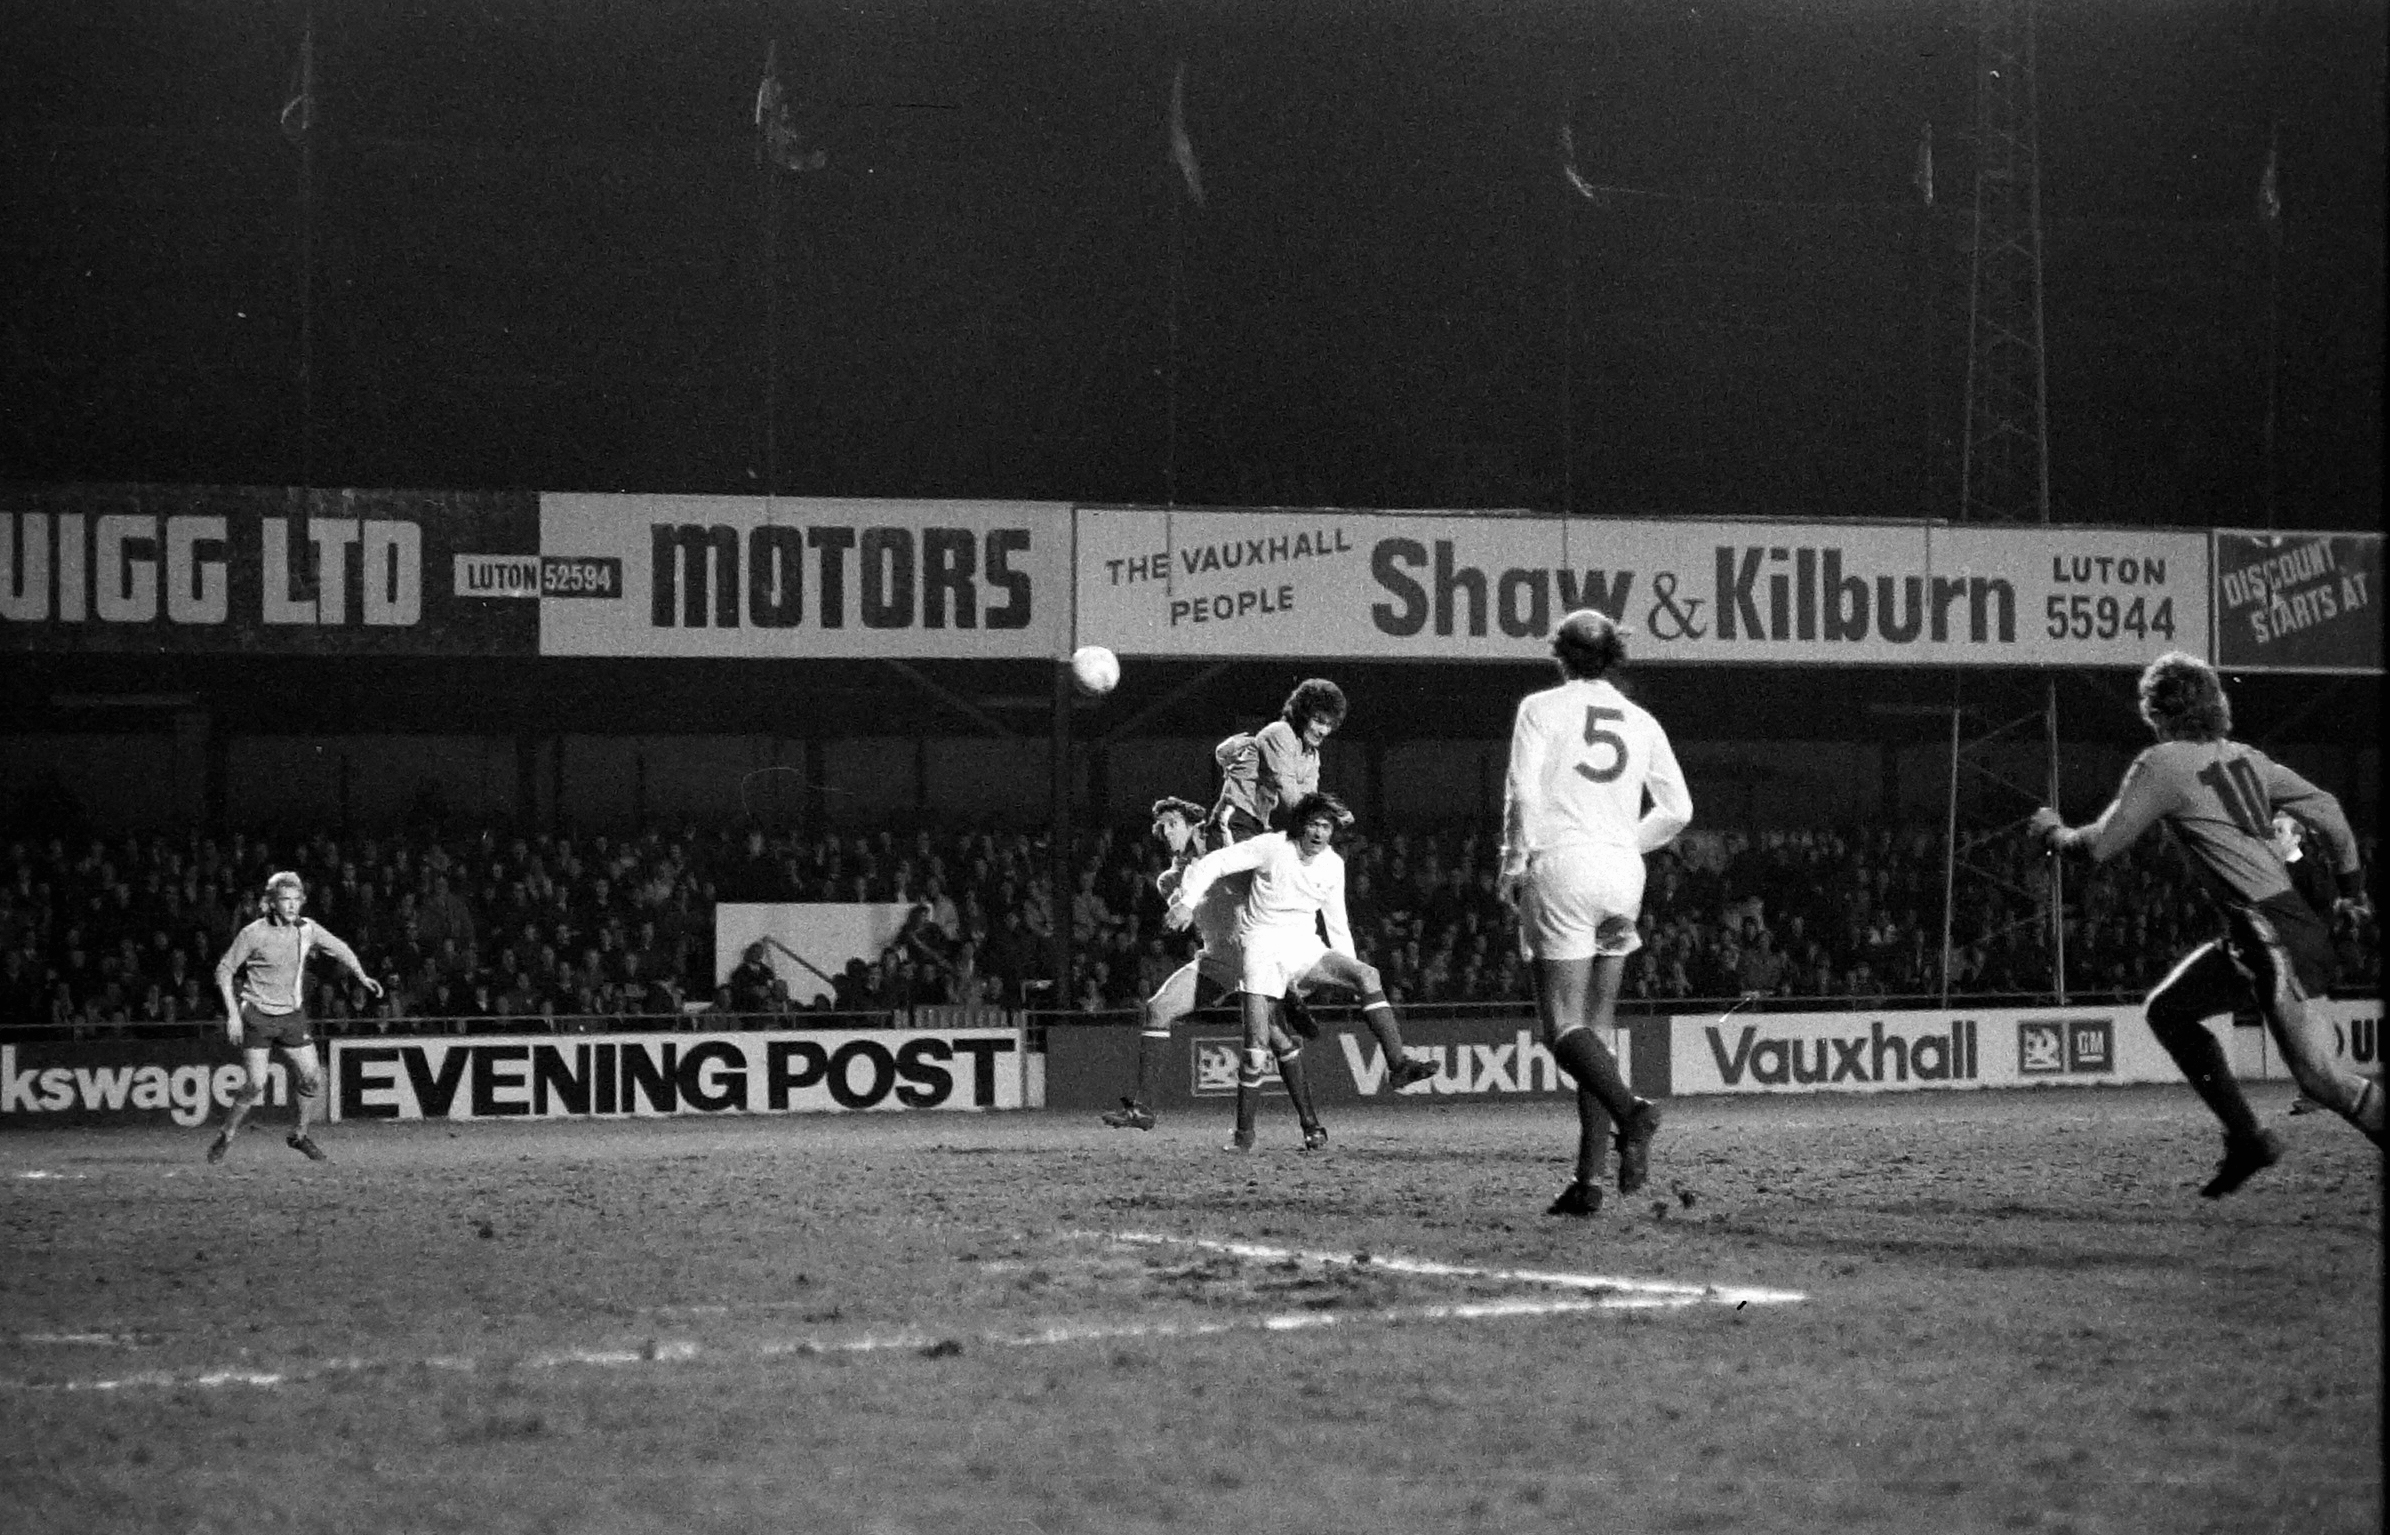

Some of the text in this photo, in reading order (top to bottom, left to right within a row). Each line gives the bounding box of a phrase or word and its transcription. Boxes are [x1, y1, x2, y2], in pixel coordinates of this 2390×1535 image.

[0, 512, 422, 625] UIGG LTD
[468, 563, 537, 590] LUTON
[651, 523, 1031, 629] MOTORS
[1106, 528, 1351, 586] THE VAUXHALL
[1371, 537, 2016, 644] Shaw & Kilburn
[2052, 557, 2166, 585] LUTON
[2223, 536, 2335, 609] DISCOUNT
[1170, 585, 1294, 626] PEOPLE
[2046, 596, 2175, 640] 55944
[2251, 573, 2367, 643] STARTS AT
[1573, 705, 1629, 783] 5
[2197, 757, 2276, 840] 10
[340, 1038, 1015, 1119] EVENING POST
[1705, 1020, 1978, 1086] Vauxhall
